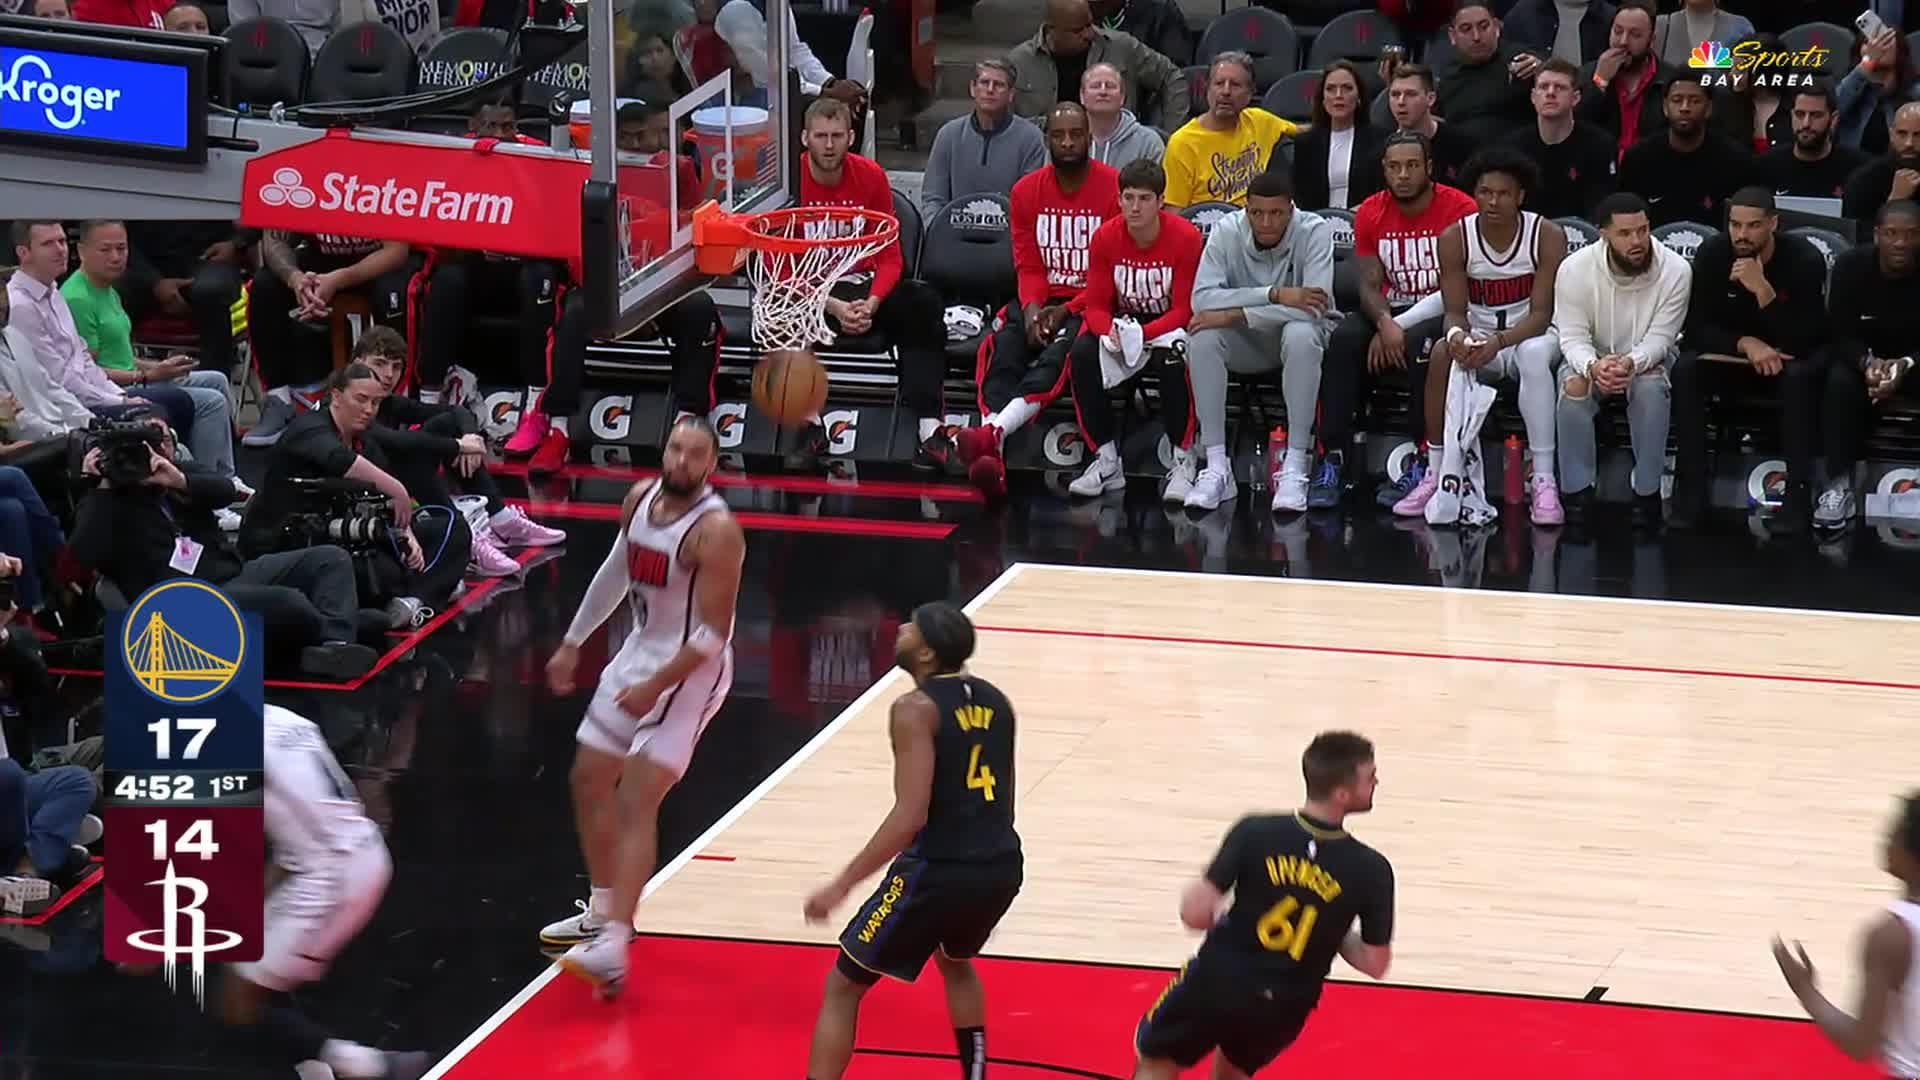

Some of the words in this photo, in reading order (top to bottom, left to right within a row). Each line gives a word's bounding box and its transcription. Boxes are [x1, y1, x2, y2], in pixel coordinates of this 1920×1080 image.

[0, 54, 121, 129] Kroger
[319, 172, 421, 217] State
[419, 180, 514, 225] Farm
[589, 395, 633, 440] G
[967, 744, 994, 801] 4
[857, 874, 905, 944] WARRIORS
[1256, 895, 1318, 961] 61
